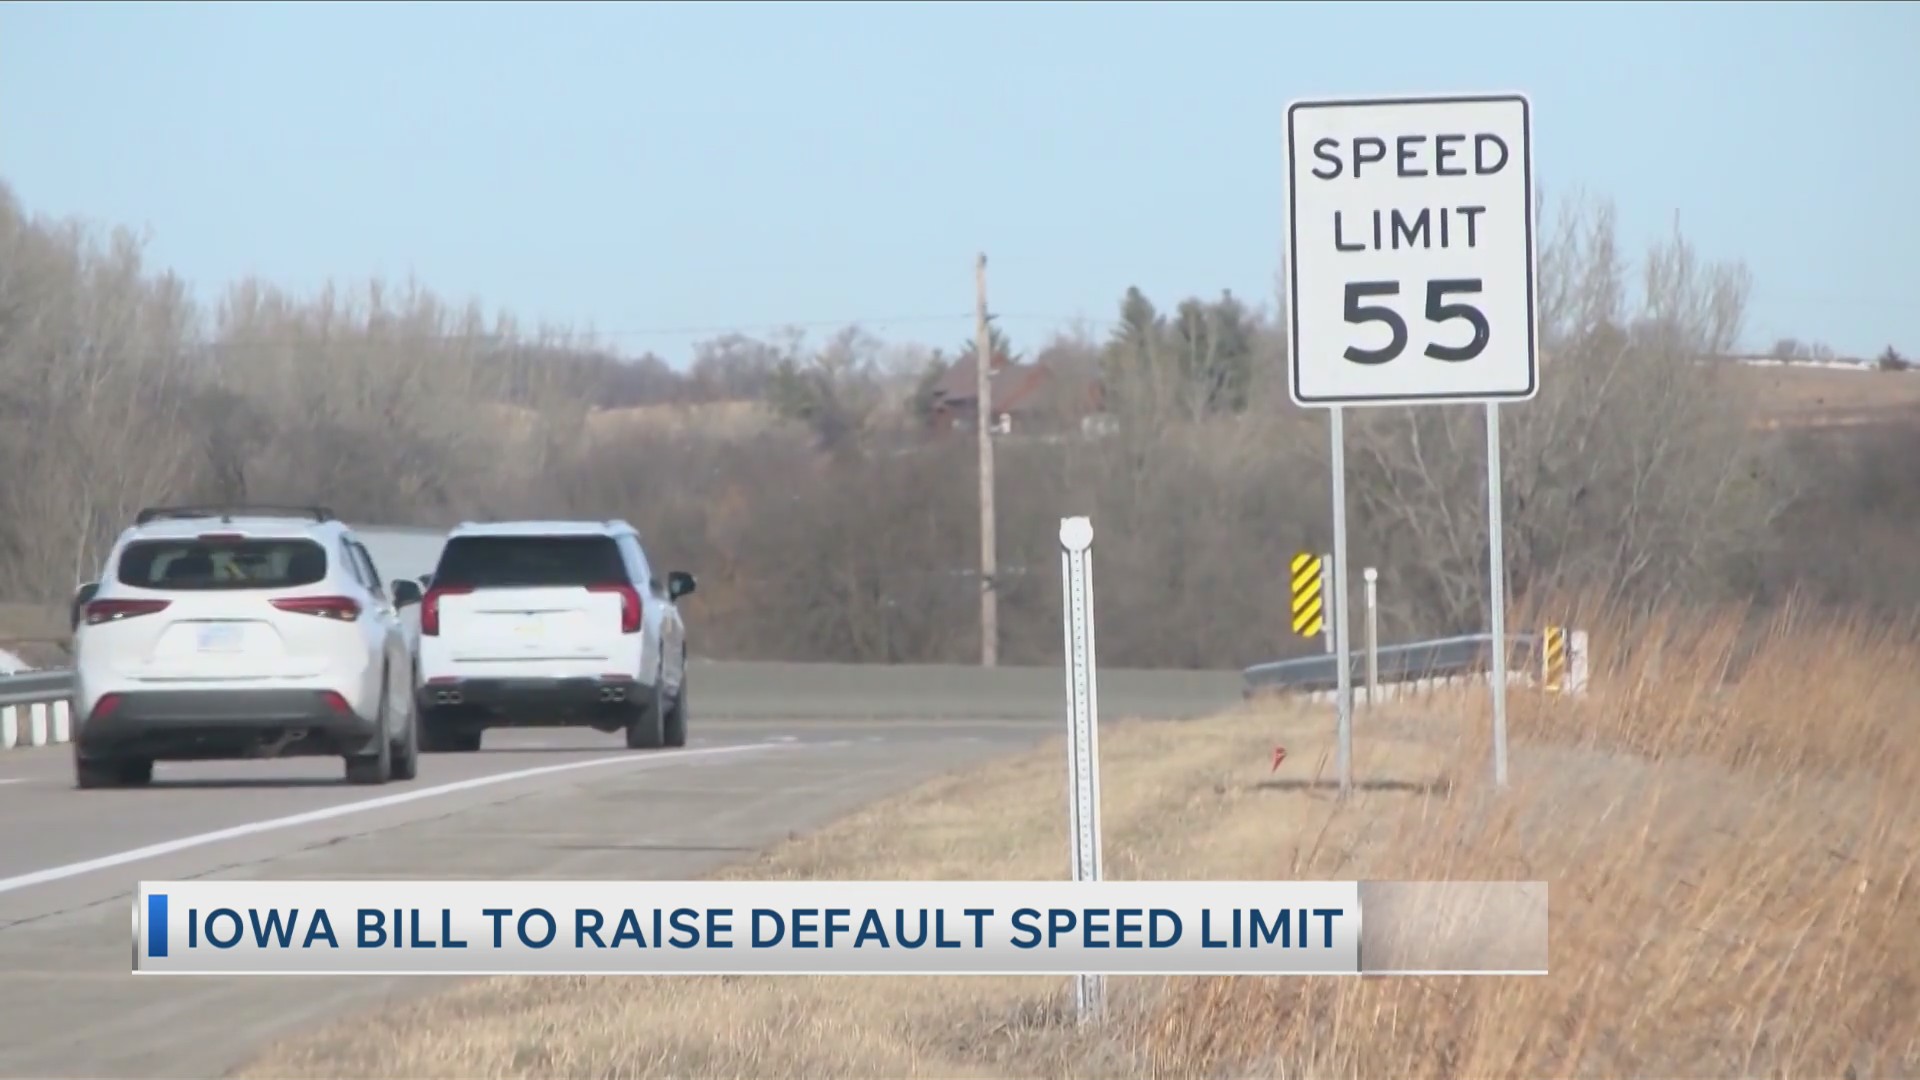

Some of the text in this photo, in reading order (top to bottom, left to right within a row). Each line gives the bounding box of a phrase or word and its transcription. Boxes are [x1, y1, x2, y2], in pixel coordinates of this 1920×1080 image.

[1311, 133, 1509, 180] SPEED
[1333, 206, 1487, 251] LIMIT
[1343, 278, 1491, 366] 55
